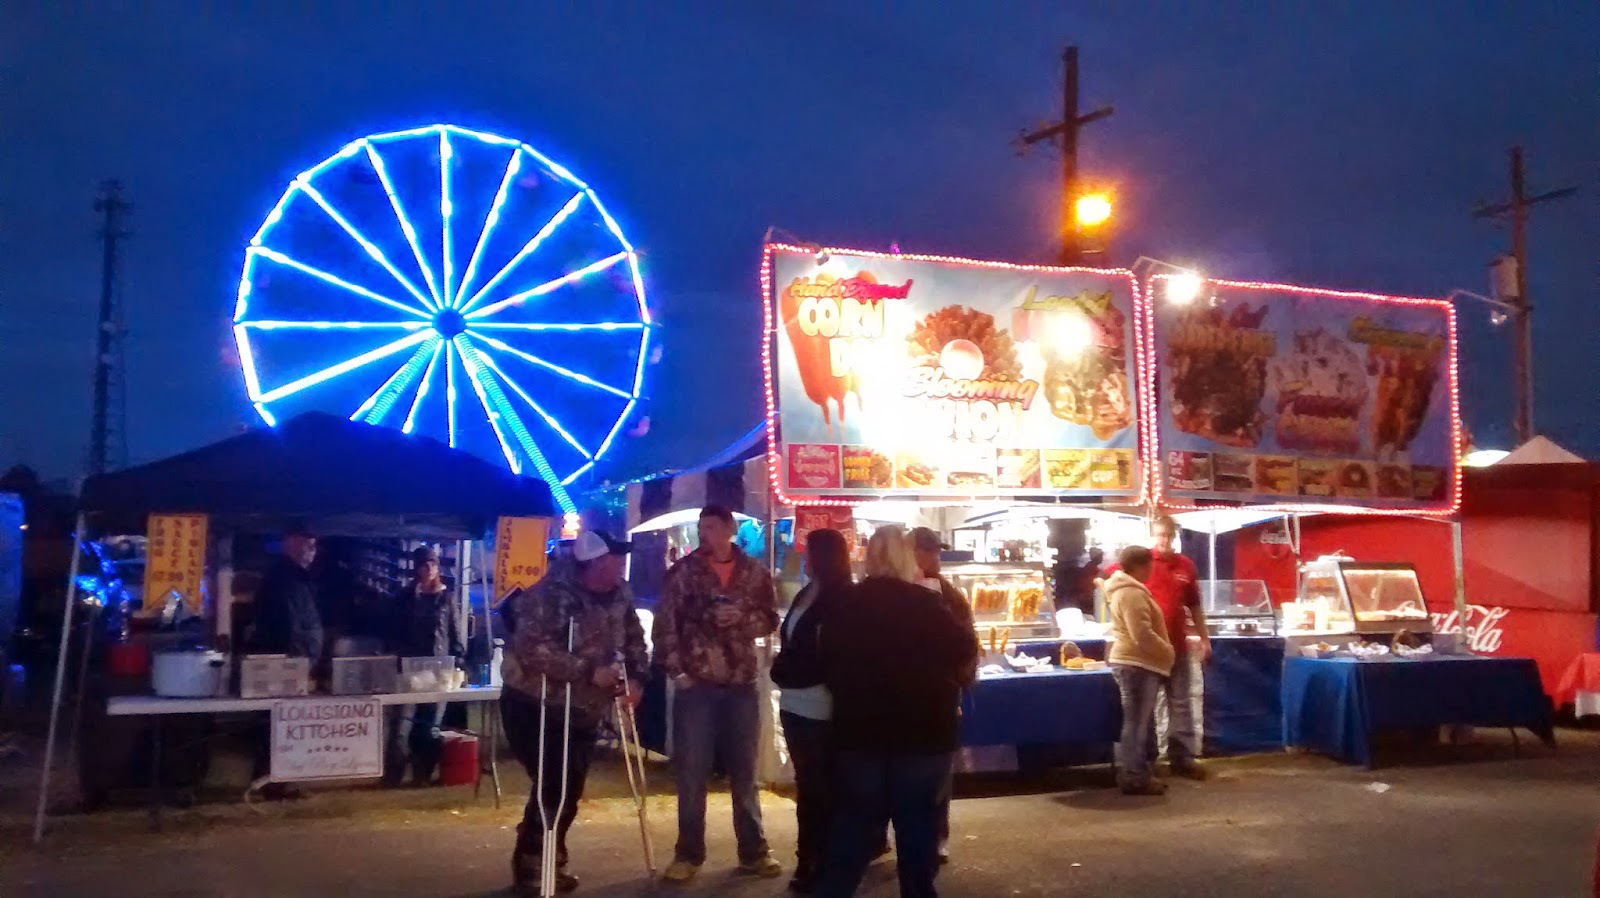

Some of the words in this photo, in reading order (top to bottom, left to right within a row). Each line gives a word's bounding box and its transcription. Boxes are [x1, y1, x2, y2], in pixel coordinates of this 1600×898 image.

[798, 297, 885, 338] CORN
[901, 365, 1040, 411] Blooming
[286, 721, 369, 741] KITCHEN
